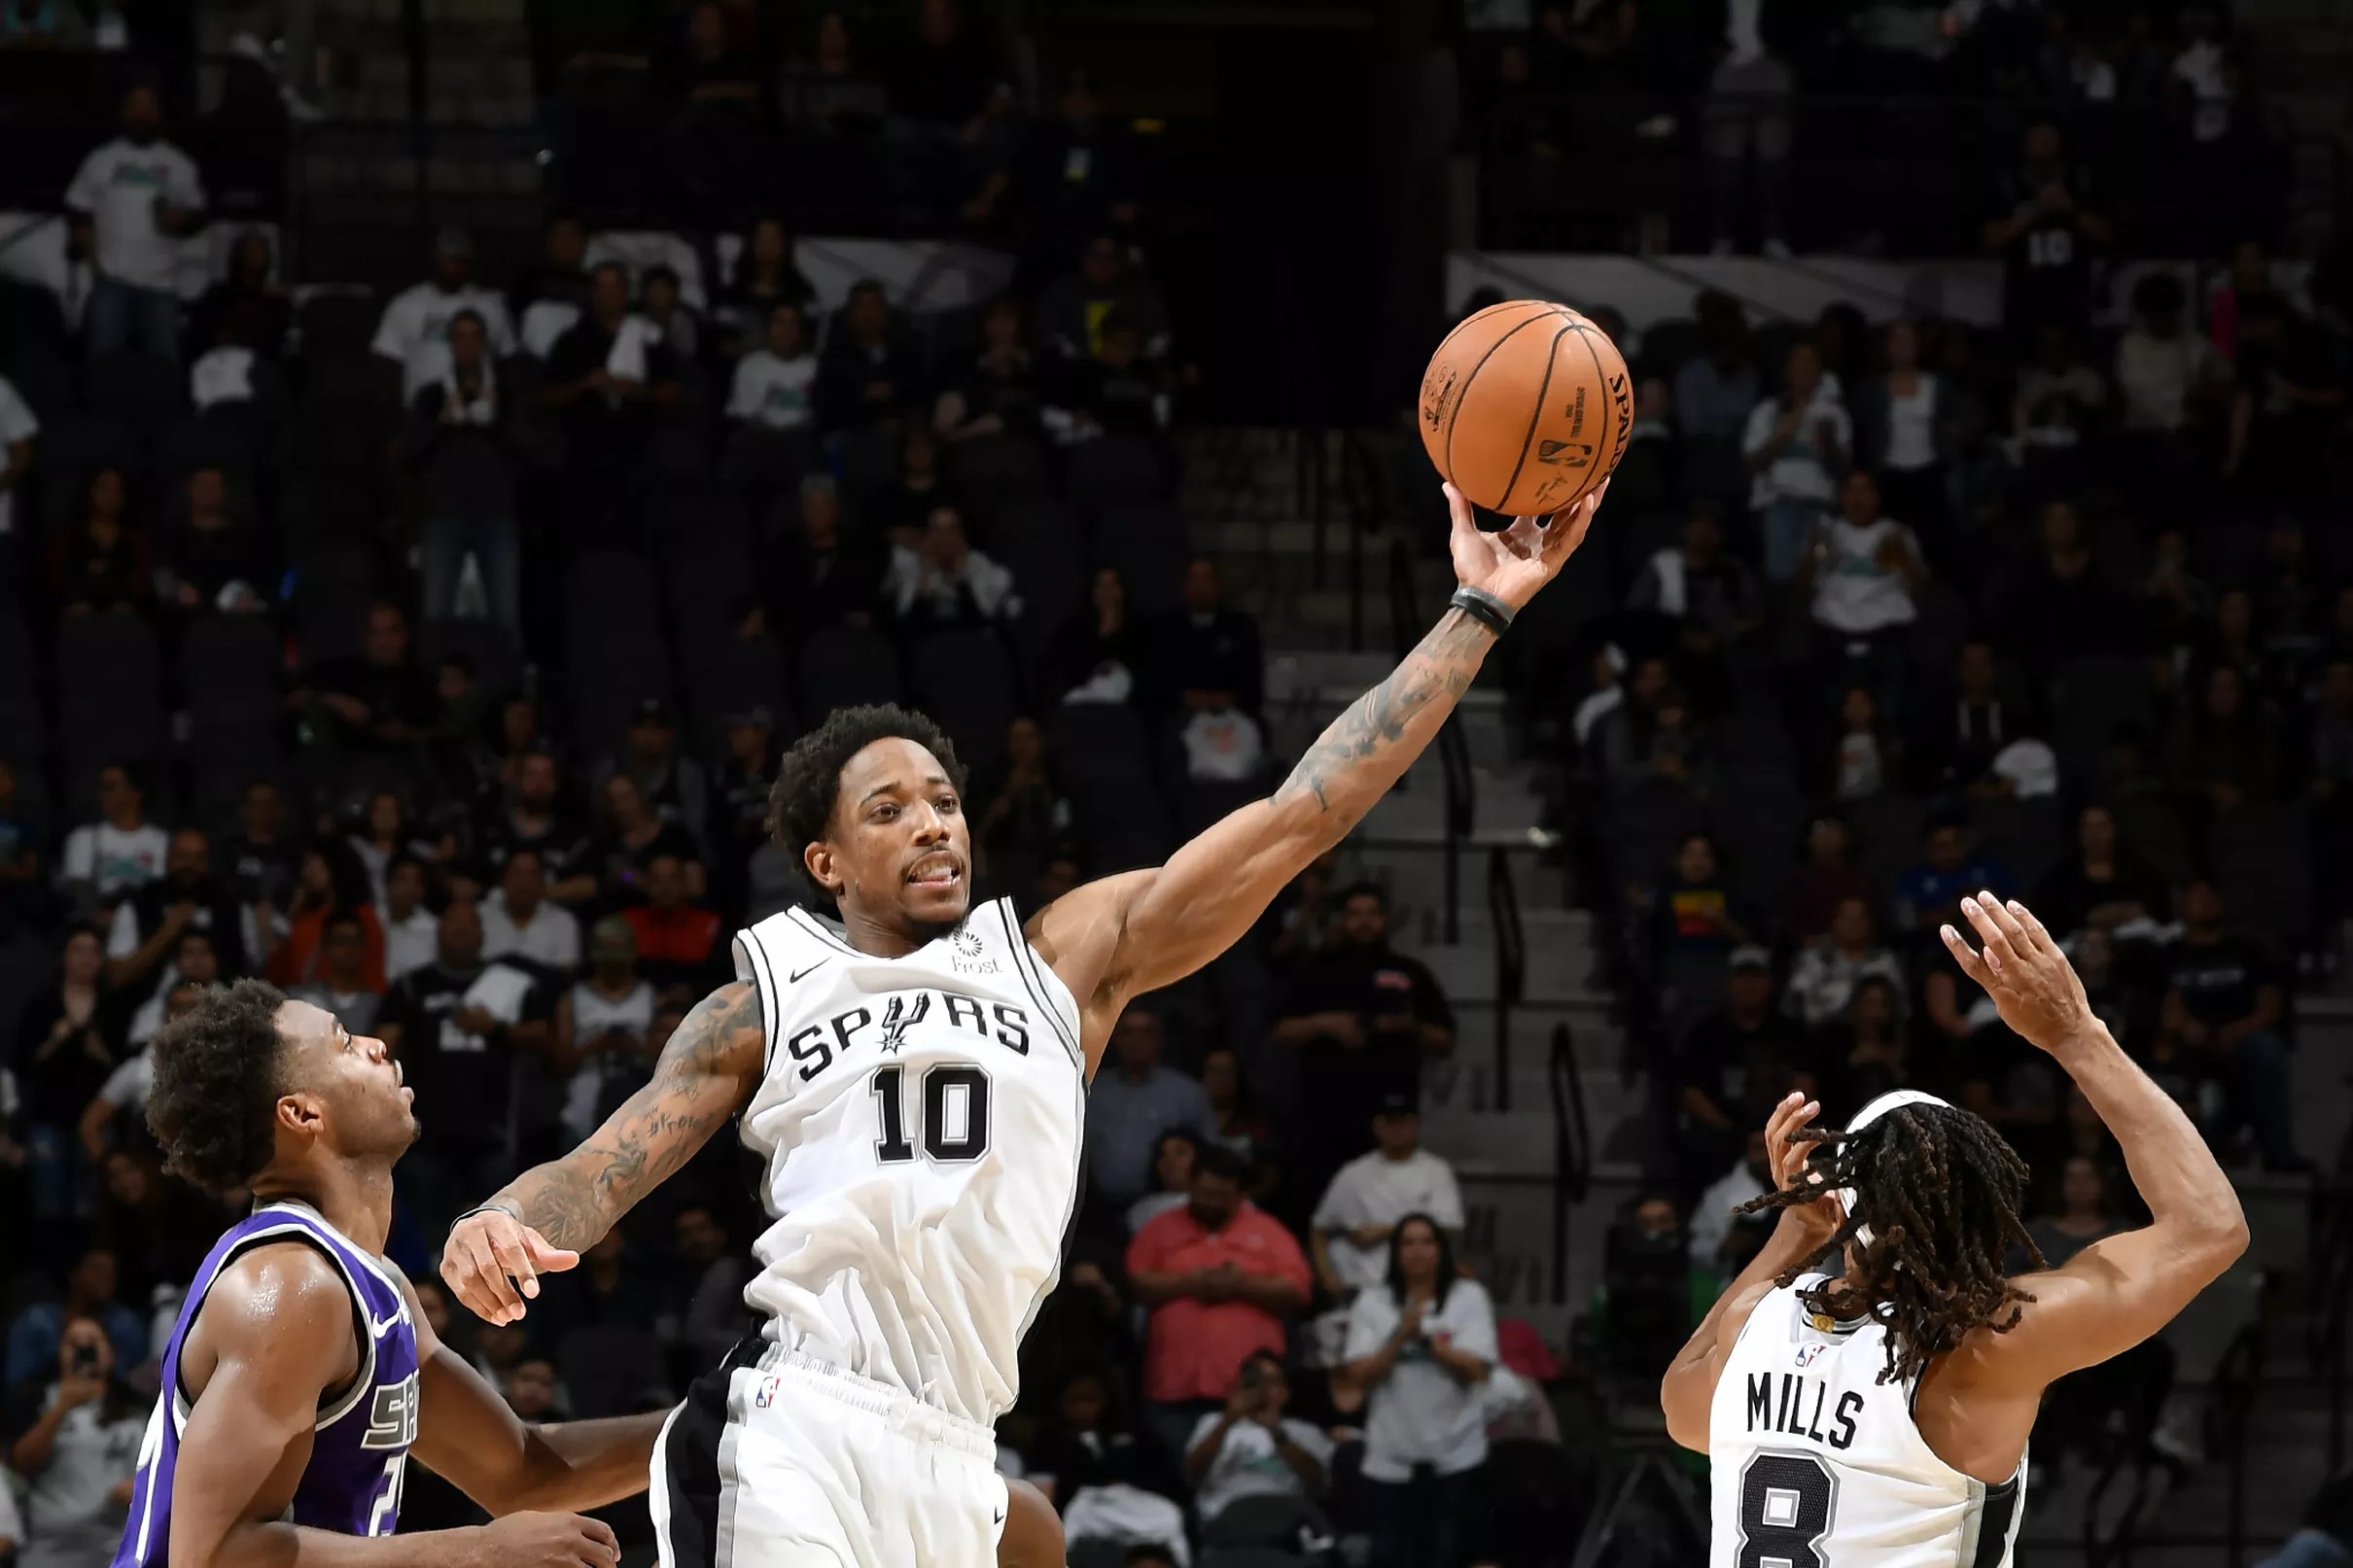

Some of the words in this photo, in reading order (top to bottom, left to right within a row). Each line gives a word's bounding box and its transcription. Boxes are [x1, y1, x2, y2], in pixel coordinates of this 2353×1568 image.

[951, 955, 1002, 974] Frost
[789, 992, 1030, 1082] SPURS
[868, 1063, 993, 1166] 10
[1747, 1372, 1865, 1450] MILLS
[369, 1447, 408, 1538] 2
[1734, 1446, 1841, 1568] 8
